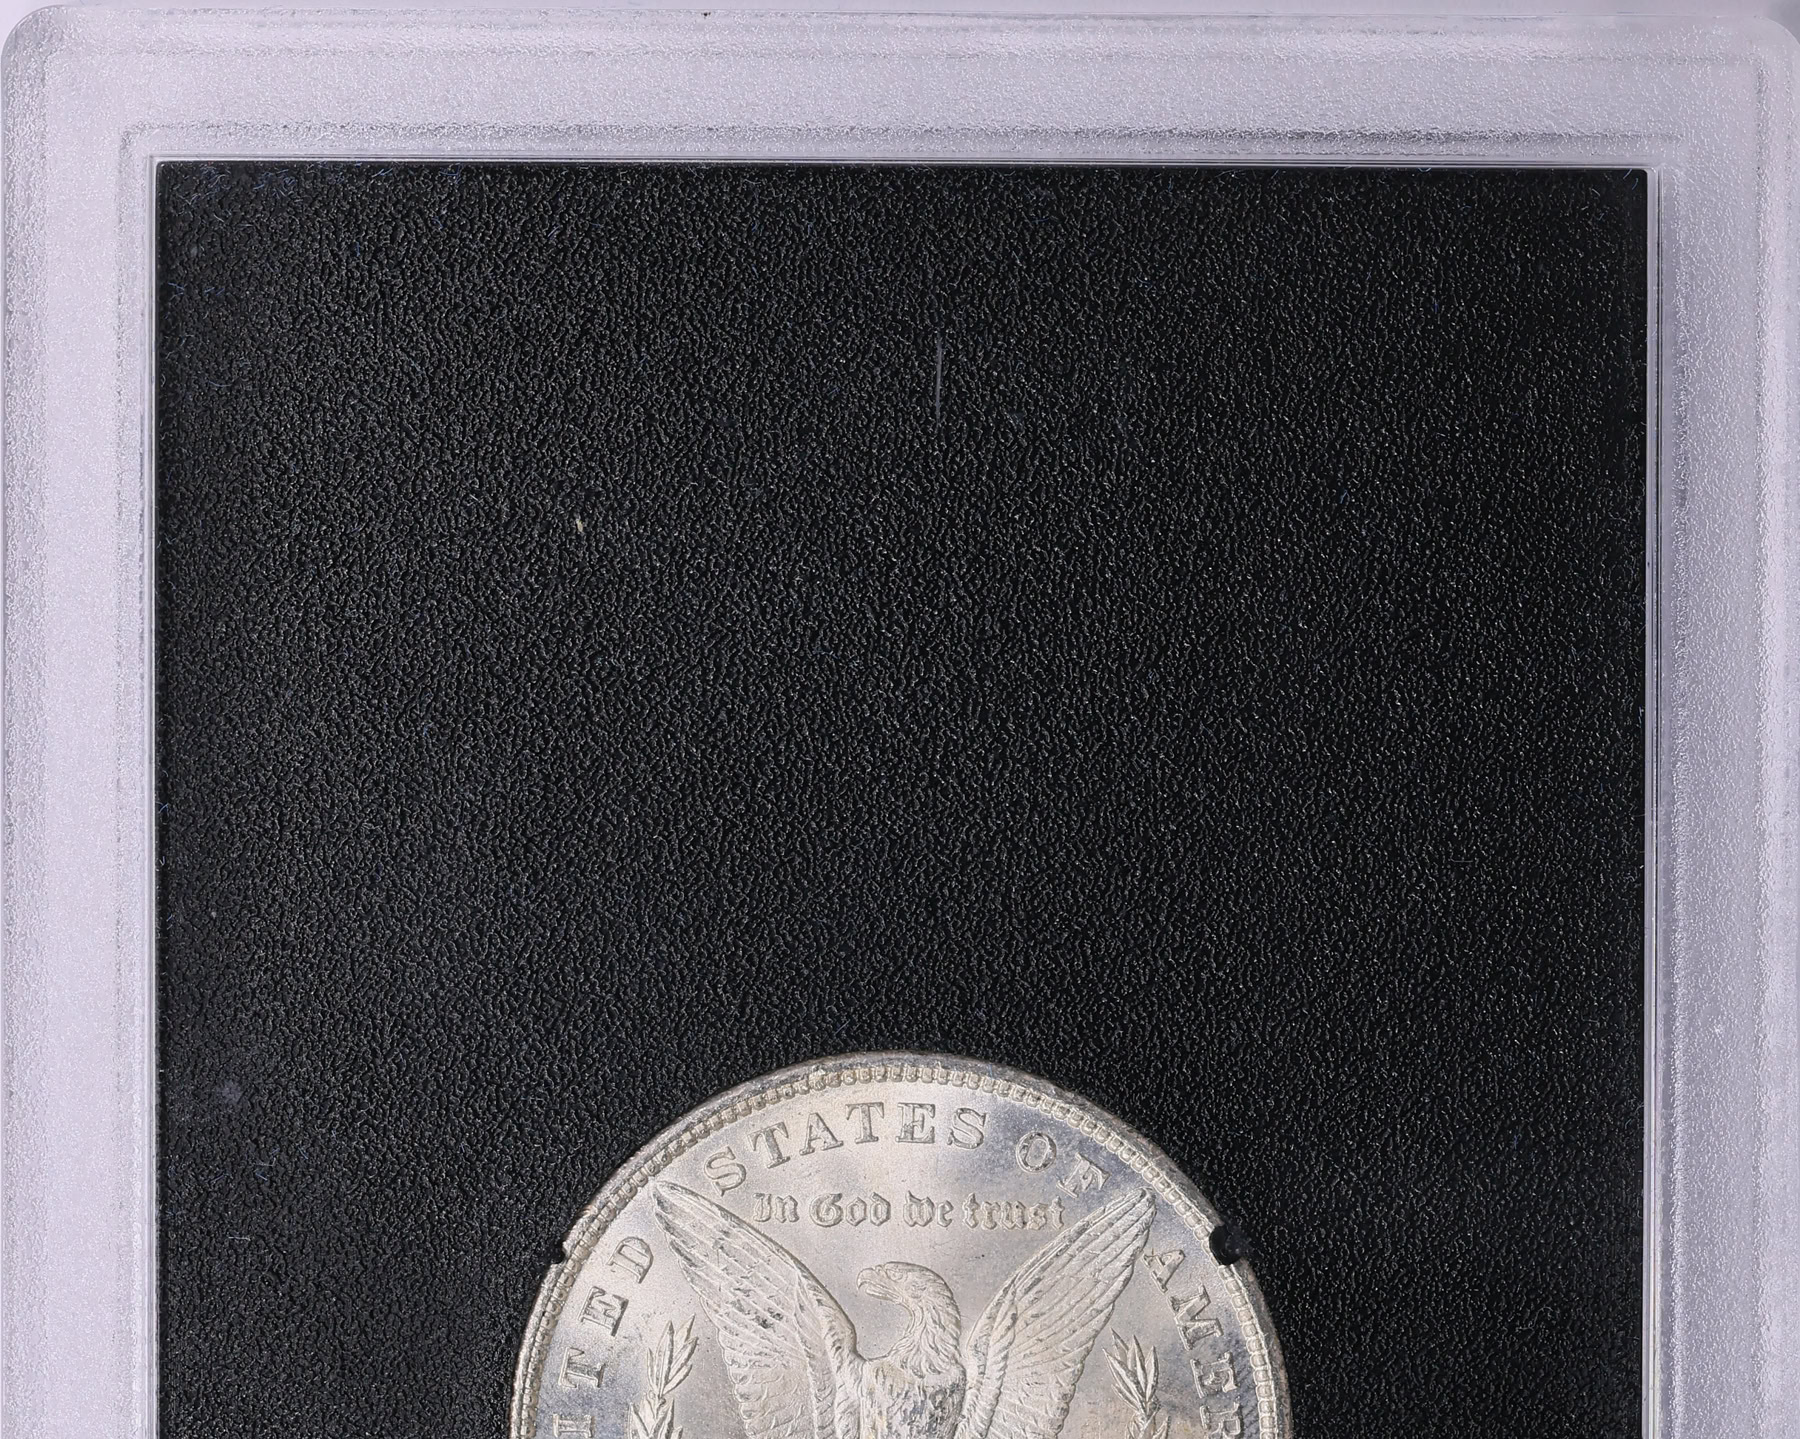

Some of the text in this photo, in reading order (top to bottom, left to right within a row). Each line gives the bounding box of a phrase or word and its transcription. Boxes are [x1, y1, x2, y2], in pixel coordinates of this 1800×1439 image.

[702, 1101, 988, 1197] STATES
[1014, 1129, 1112, 1199] OF
[752, 1192, 799, 1223] In
[808, 1191, 892, 1228] God
[962, 1192, 1067, 1231] trust
